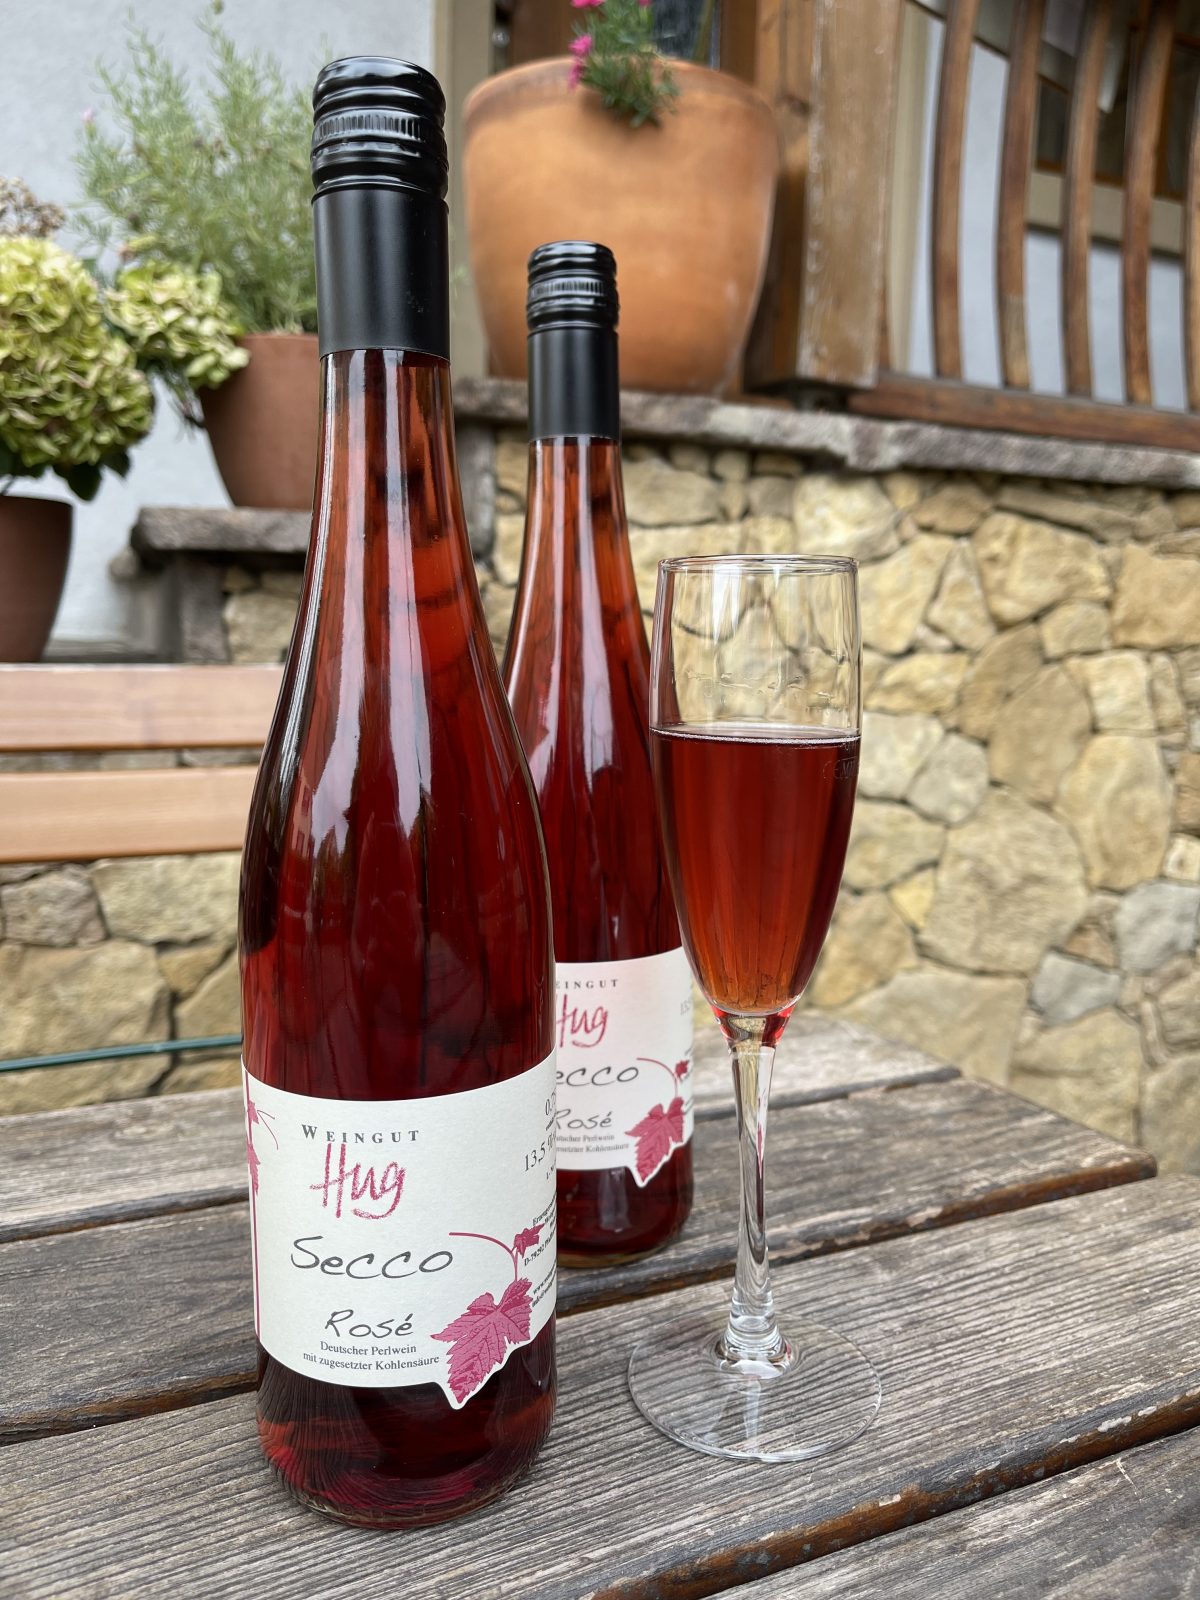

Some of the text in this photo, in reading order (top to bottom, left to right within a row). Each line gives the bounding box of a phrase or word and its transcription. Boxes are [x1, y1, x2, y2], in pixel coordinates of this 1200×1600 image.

[556, 979, 618, 989] EINGUT
[556, 1066, 639, 1087] ecco
[301, 1124, 419, 1144] WEINGUT
[309, 1143, 406, 1219] Hug
[290, 1235, 453, 1280] Secco
[325, 1309, 413, 1338] Rosé
[320, 1340, 417, 1356] Deutscher Perlwein
[303, 1352, 440, 1370] mit zugesetzter Kohlensäure
